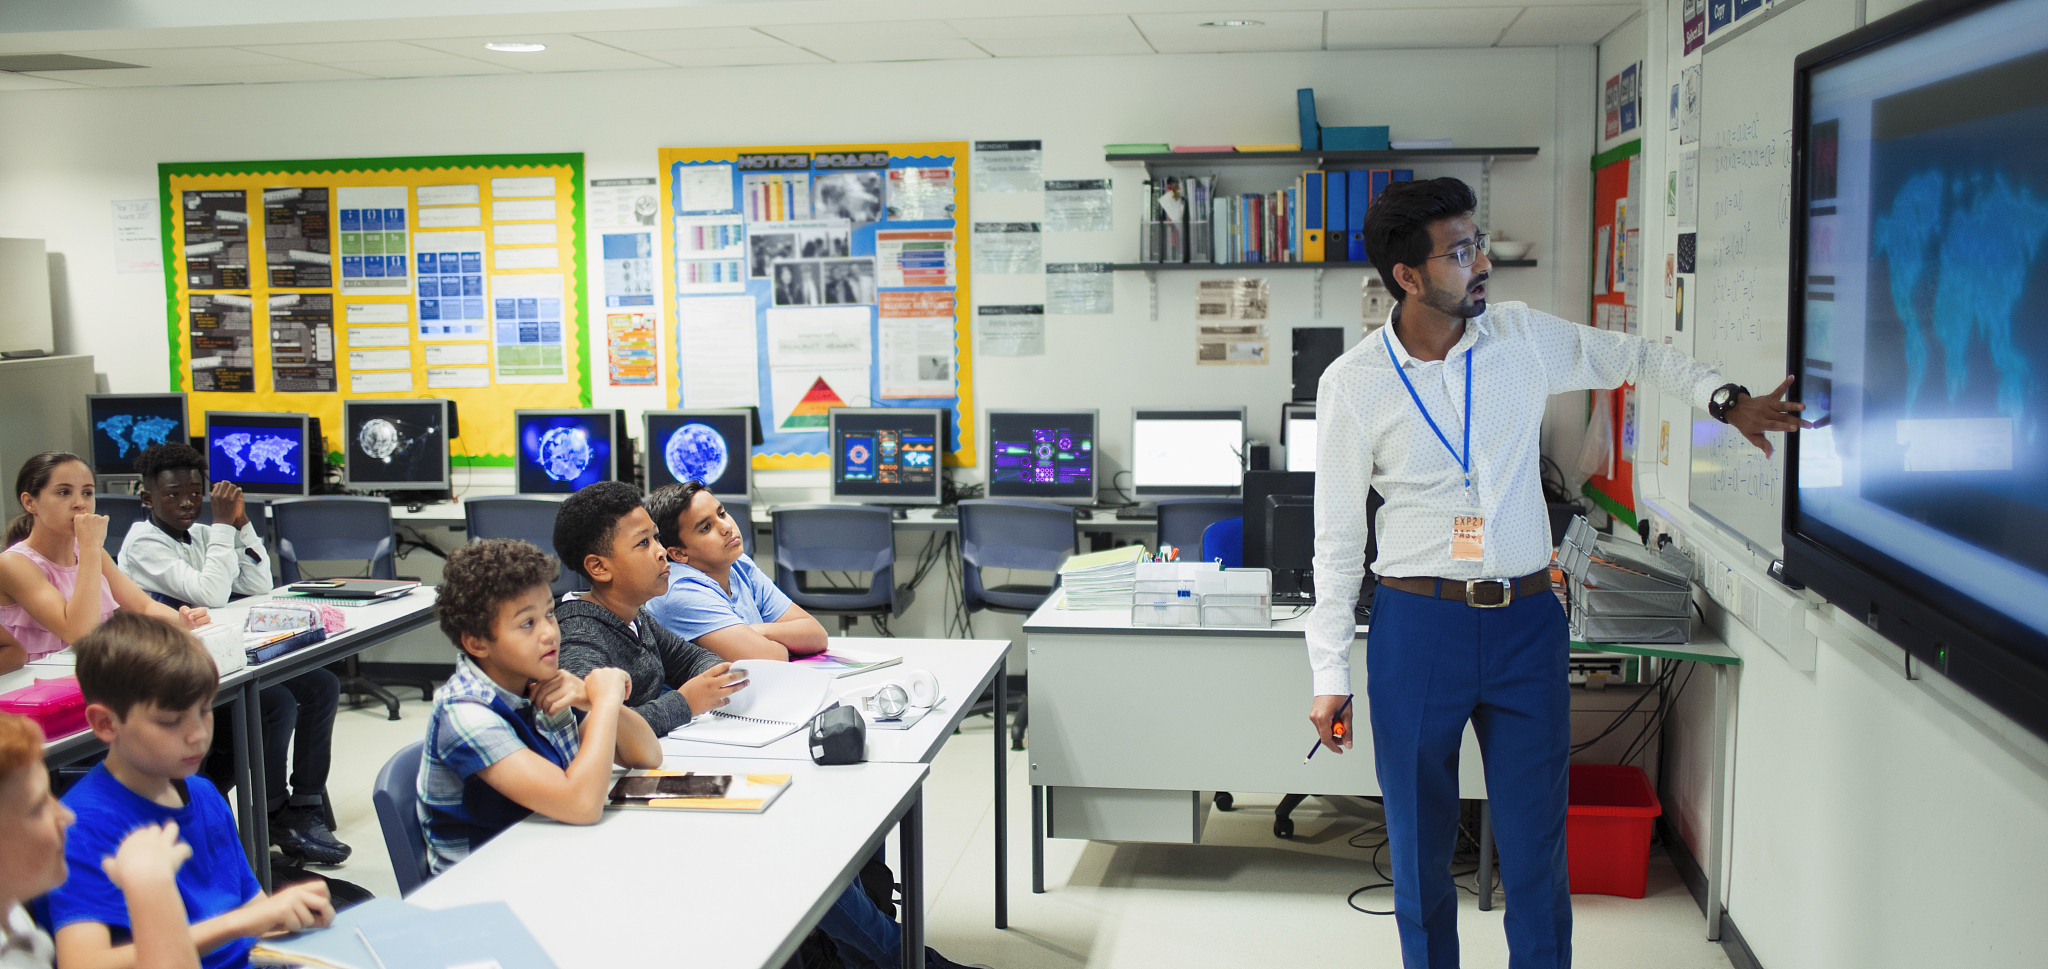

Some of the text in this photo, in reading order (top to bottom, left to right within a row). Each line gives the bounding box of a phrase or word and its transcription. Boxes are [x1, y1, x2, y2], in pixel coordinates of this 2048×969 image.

[1714, 4, 1726, 20] Copy
[738, 153, 889, 169] NOTICE BOARD
[1454, 516, 1483, 526] EXP21
